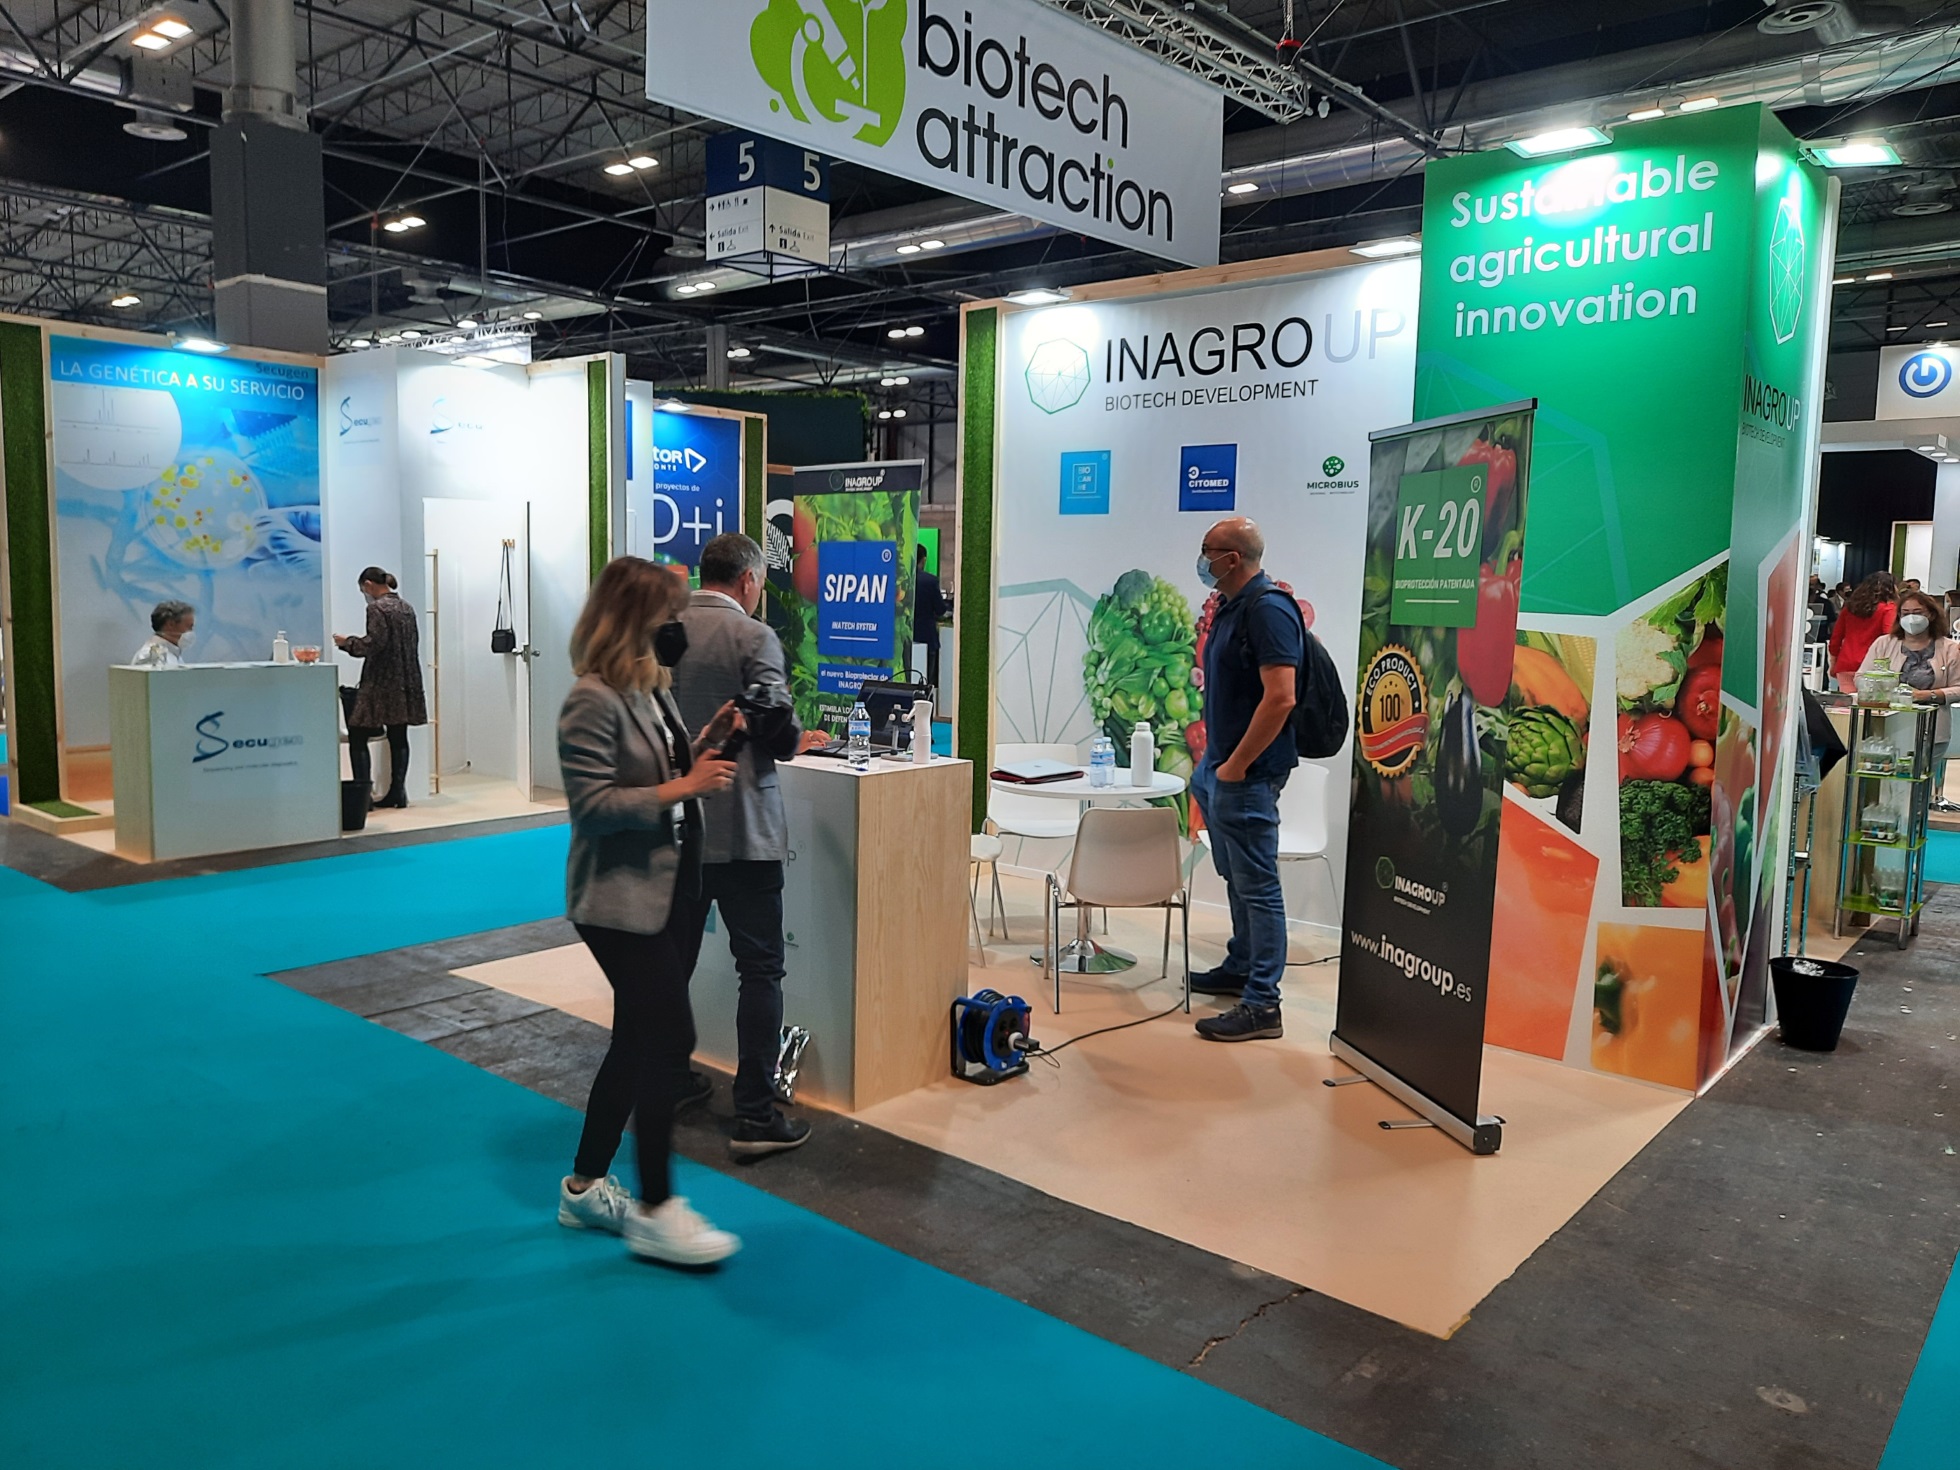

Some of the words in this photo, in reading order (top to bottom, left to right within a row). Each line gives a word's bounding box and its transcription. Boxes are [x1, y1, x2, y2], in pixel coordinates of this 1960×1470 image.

[918, 0, 1128, 149] biotech
[738, 140, 755, 182] 5
[804, 151, 821, 192] 5
[916, 104, 1173, 242] attraction
[717, 226, 737, 238] Salida
[779, 226, 801, 238] Salida
[1450, 211, 1714, 288] agricultural
[1455, 282, 1697, 338] innovation
[1106, 308, 1407, 383] INAGROUP
[60, 360, 83, 377] LA
[88, 362, 181, 386] GENÉTICA
[186, 373, 198, 388] A
[203, 375, 225, 391] SU
[230, 378, 305, 401] SERVICIO
[1105, 391, 1176, 412] BIOTECH
[1182, 379, 1319, 406] DEVELOPMENT
[1743, 374, 1801, 432] INAGROUP
[653, 464, 677, 472] ONTE
[845, 476, 883, 488] INAGROUP
[1188, 479, 1229, 488] CITOMED
[655, 482, 690, 492] proyectos
[691, 484, 700, 492] de
[1306, 480, 1359, 489] MICROBIUS
[1397, 498, 1480, 560] K-20
[824, 573, 888, 604] SIPAN
[1440, 578, 1475, 589] PATENTADA
[856, 622, 877, 631] SYSTEM
[827, 670, 844, 678] nuevo
[838, 681, 863, 690] INAGRO
[1365, 668, 1380, 697] ECO
[1381, 657, 1418, 691] PRODUCT
[831, 715, 848, 723] DEFEN
[1394, 875, 1446, 907] INAGROUP
[1351, 931, 1472, 1002] www.inagroup.es
